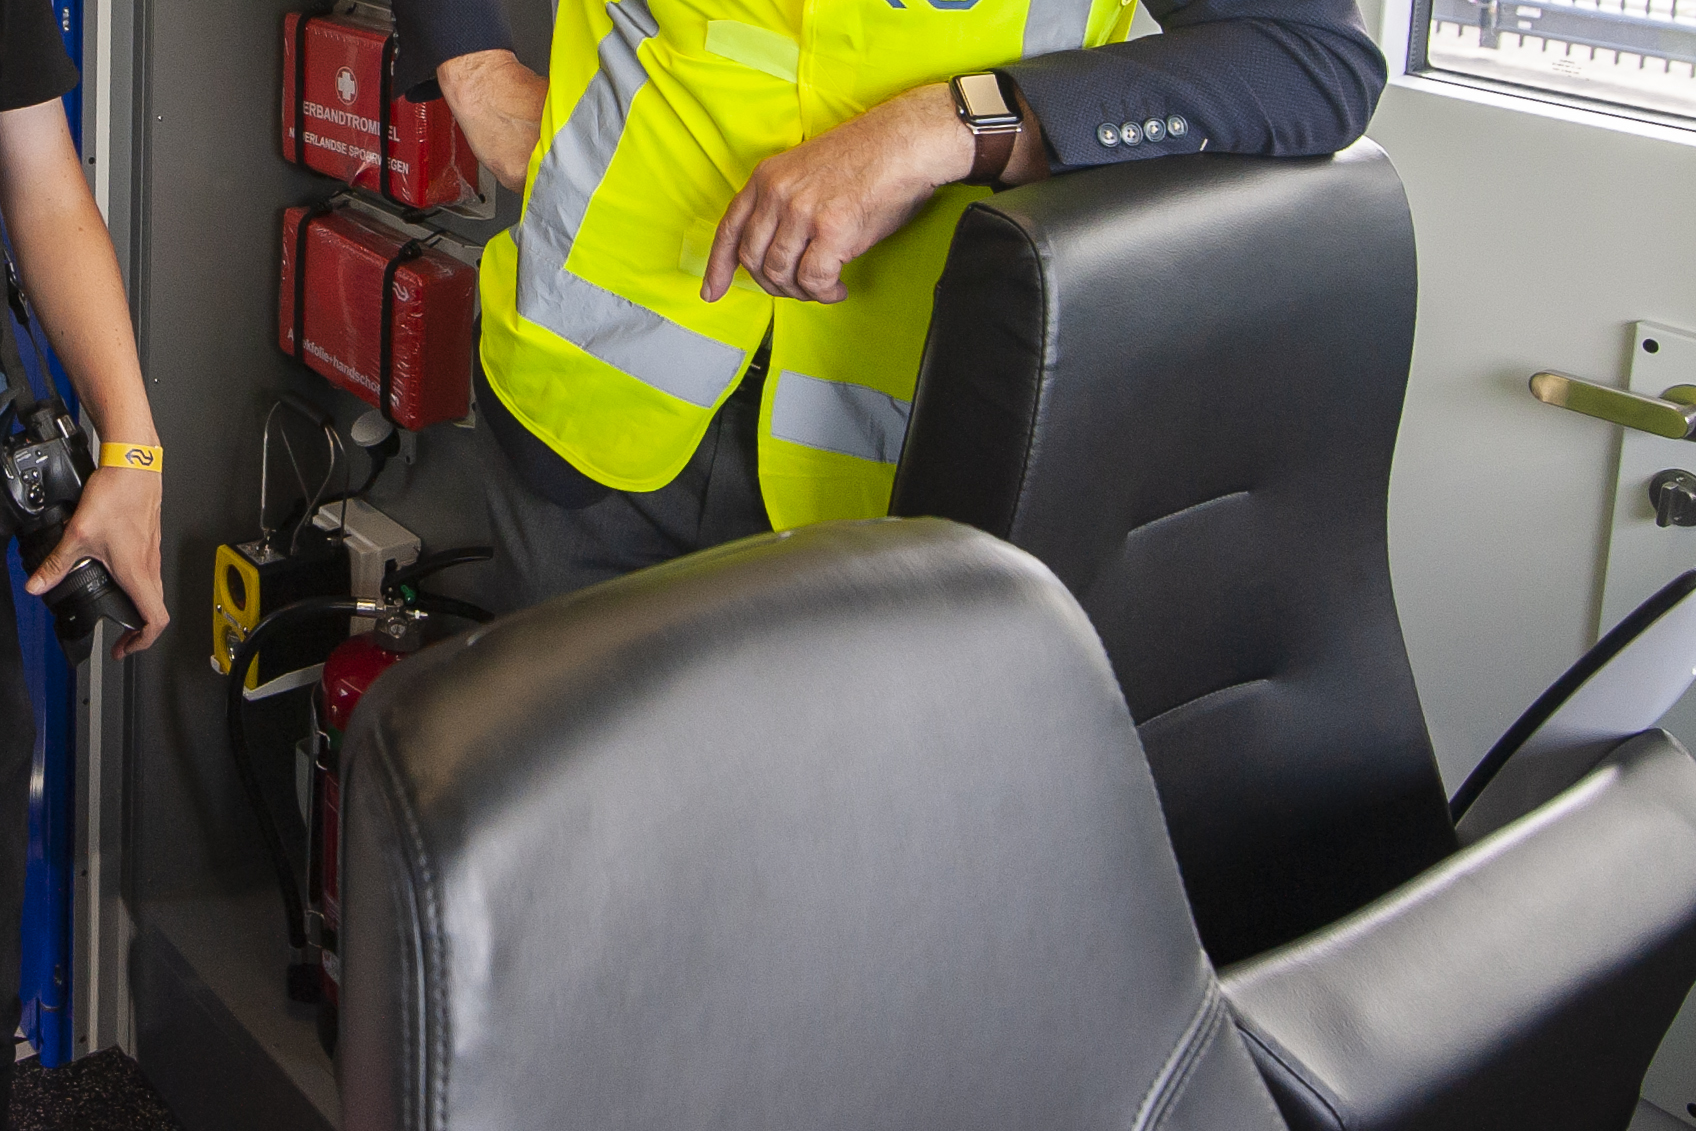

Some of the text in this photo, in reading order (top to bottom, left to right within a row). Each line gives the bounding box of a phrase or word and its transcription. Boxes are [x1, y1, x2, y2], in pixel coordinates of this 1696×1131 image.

[302, 100, 401, 142] ERBANDTROMEL
[288, 127, 410, 175] NERLANDSE SPOORGEN
